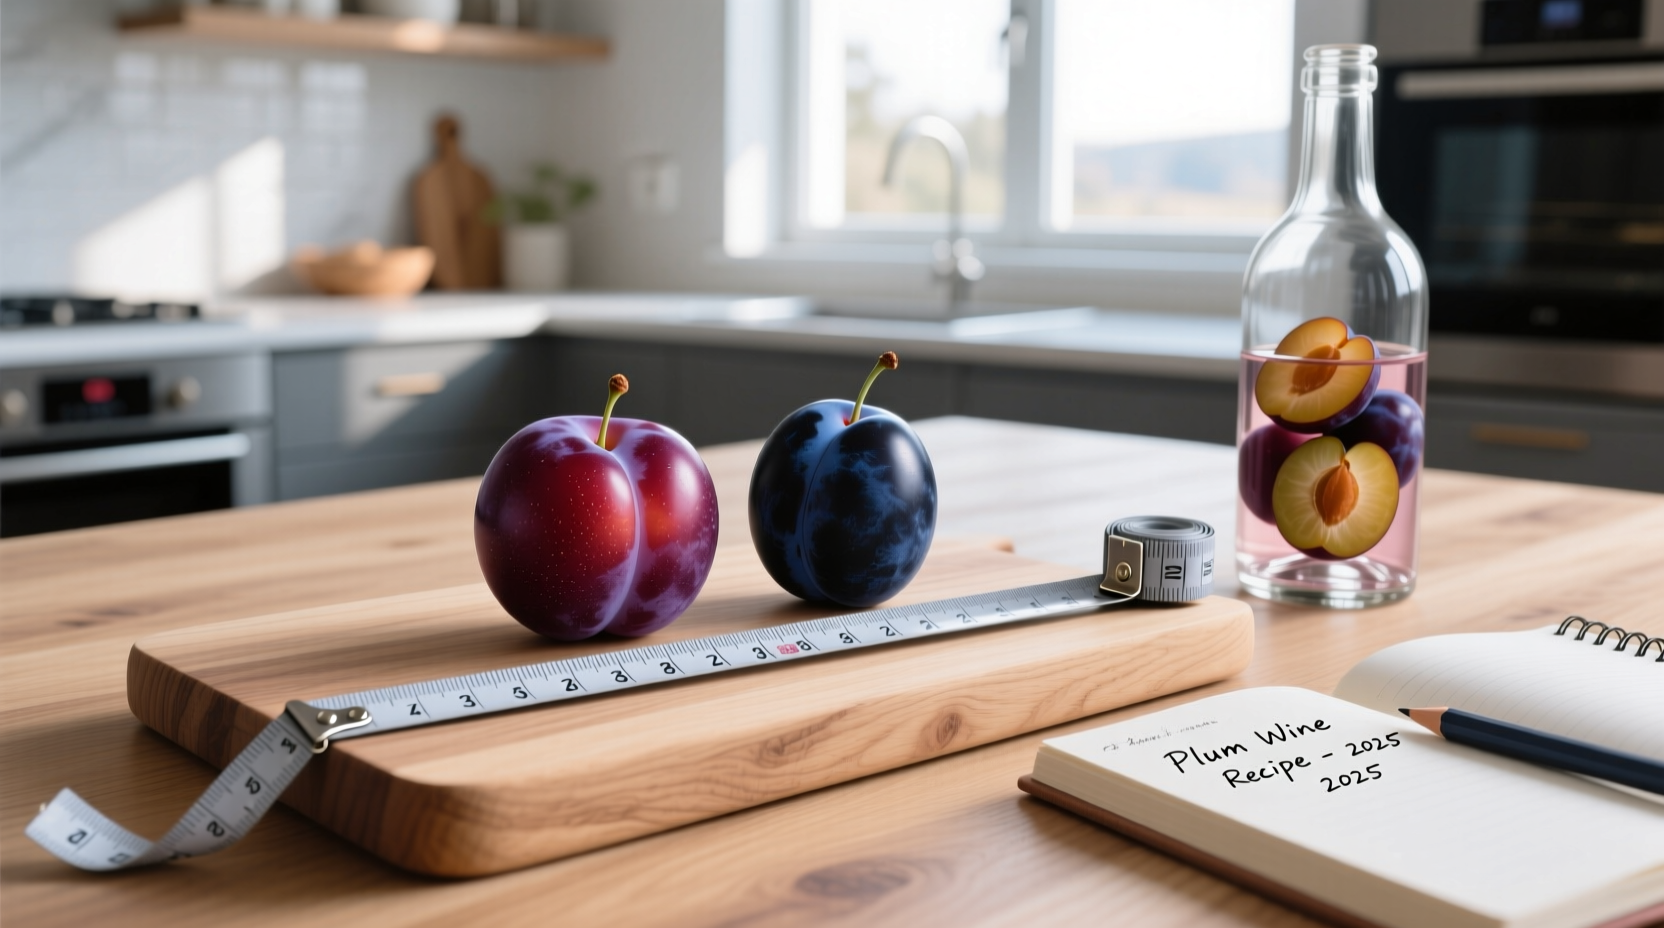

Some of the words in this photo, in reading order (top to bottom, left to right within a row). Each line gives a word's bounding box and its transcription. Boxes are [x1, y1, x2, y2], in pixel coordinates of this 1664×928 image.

[706, 654, 723, 667] 2
[1164, 741, 1247, 773] Plum
[1254, 719, 1331, 745] Wine
[1222, 756, 1311, 788] Recipe
[1345, 731, 1401, 757] 2025
[1320, 763, 1382, 793] 2025
